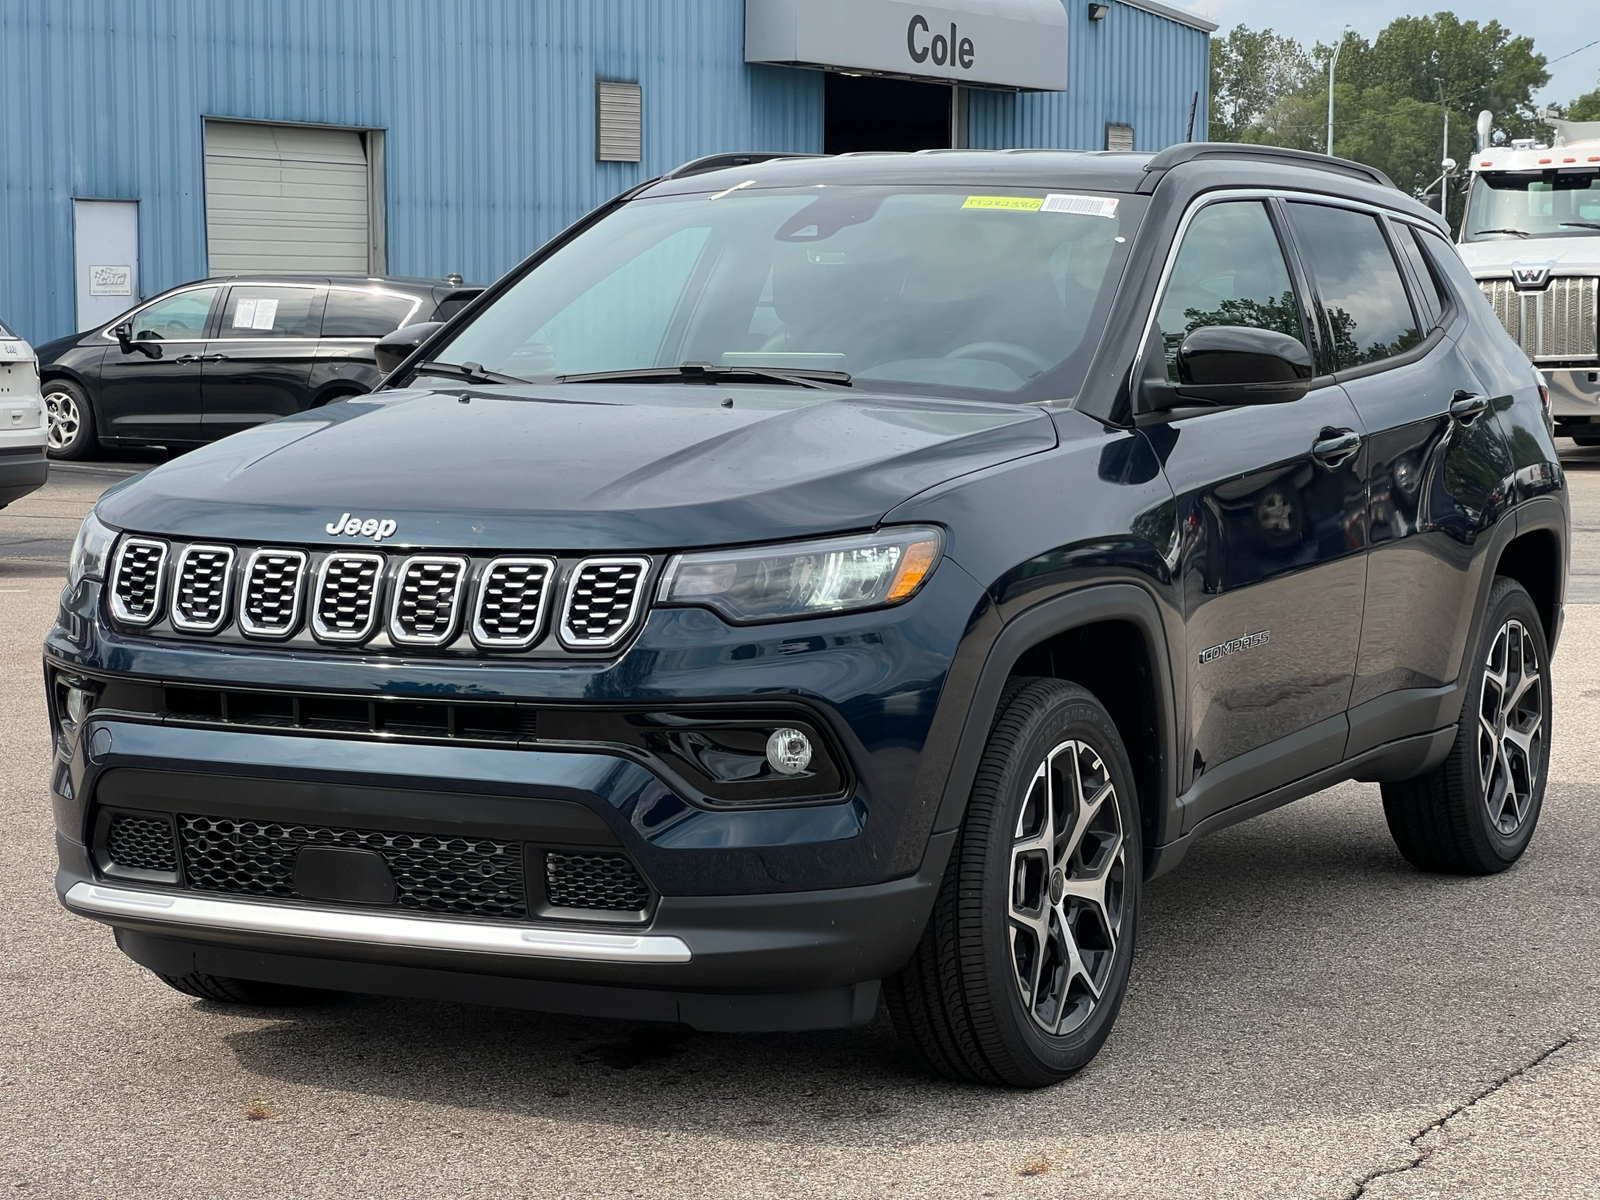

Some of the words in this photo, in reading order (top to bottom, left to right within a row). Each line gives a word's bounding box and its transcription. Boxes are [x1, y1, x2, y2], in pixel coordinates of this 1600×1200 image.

[907, 14, 975, 69] Cole
[98, 273, 125, 285] Cole
[325, 512, 398, 542] Jeep
[1199, 629, 1270, 664] COMPASS
